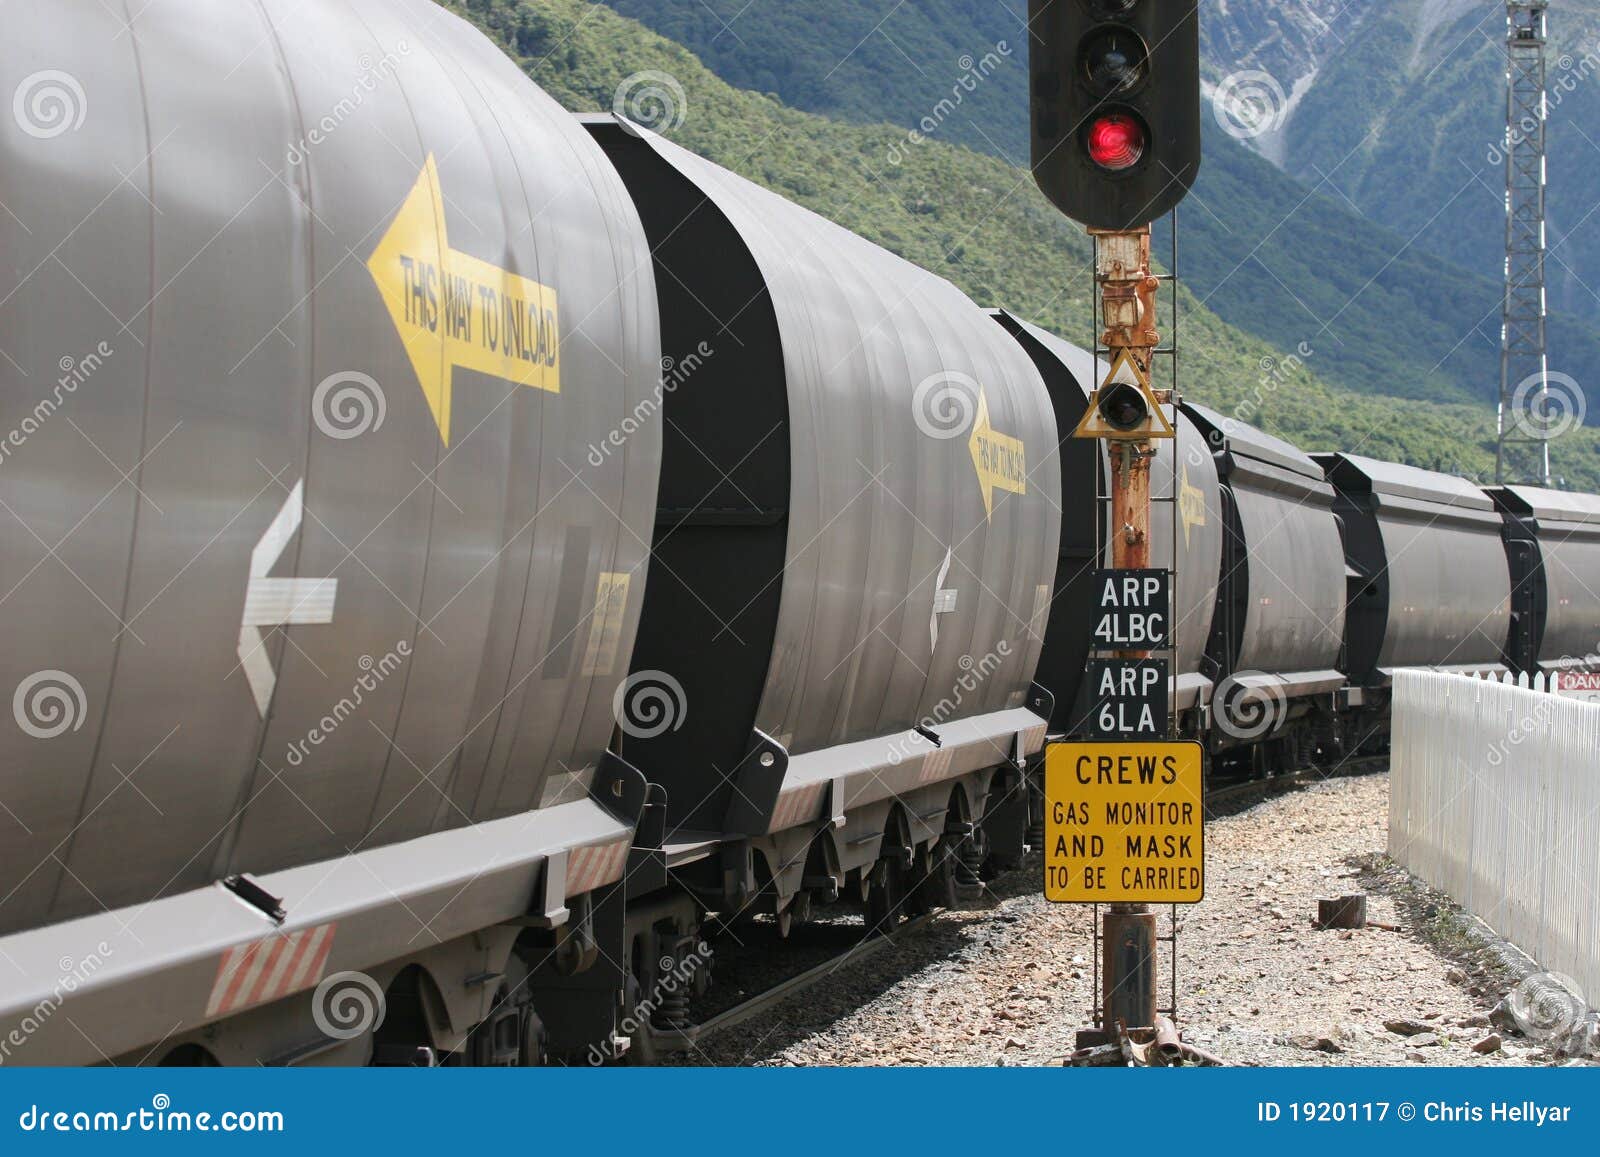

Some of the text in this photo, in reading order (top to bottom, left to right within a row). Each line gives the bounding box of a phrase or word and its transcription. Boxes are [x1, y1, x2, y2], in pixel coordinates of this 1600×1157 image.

[400, 254, 556, 368] THIS WAY TO UNLOAD
[1101, 577, 1160, 607] ARP
[1095, 613, 1163, 642] 4LBC
[1099, 667, 1159, 696] ARP
[1099, 702, 1156, 732] 6LA
[1076, 756, 1177, 784] CREWS
[1053, 802, 1193, 825] GAS MONITOR
[1055, 835, 1193, 858] AND MASK
[1048, 866, 1200, 890] TO BE CARRIED
